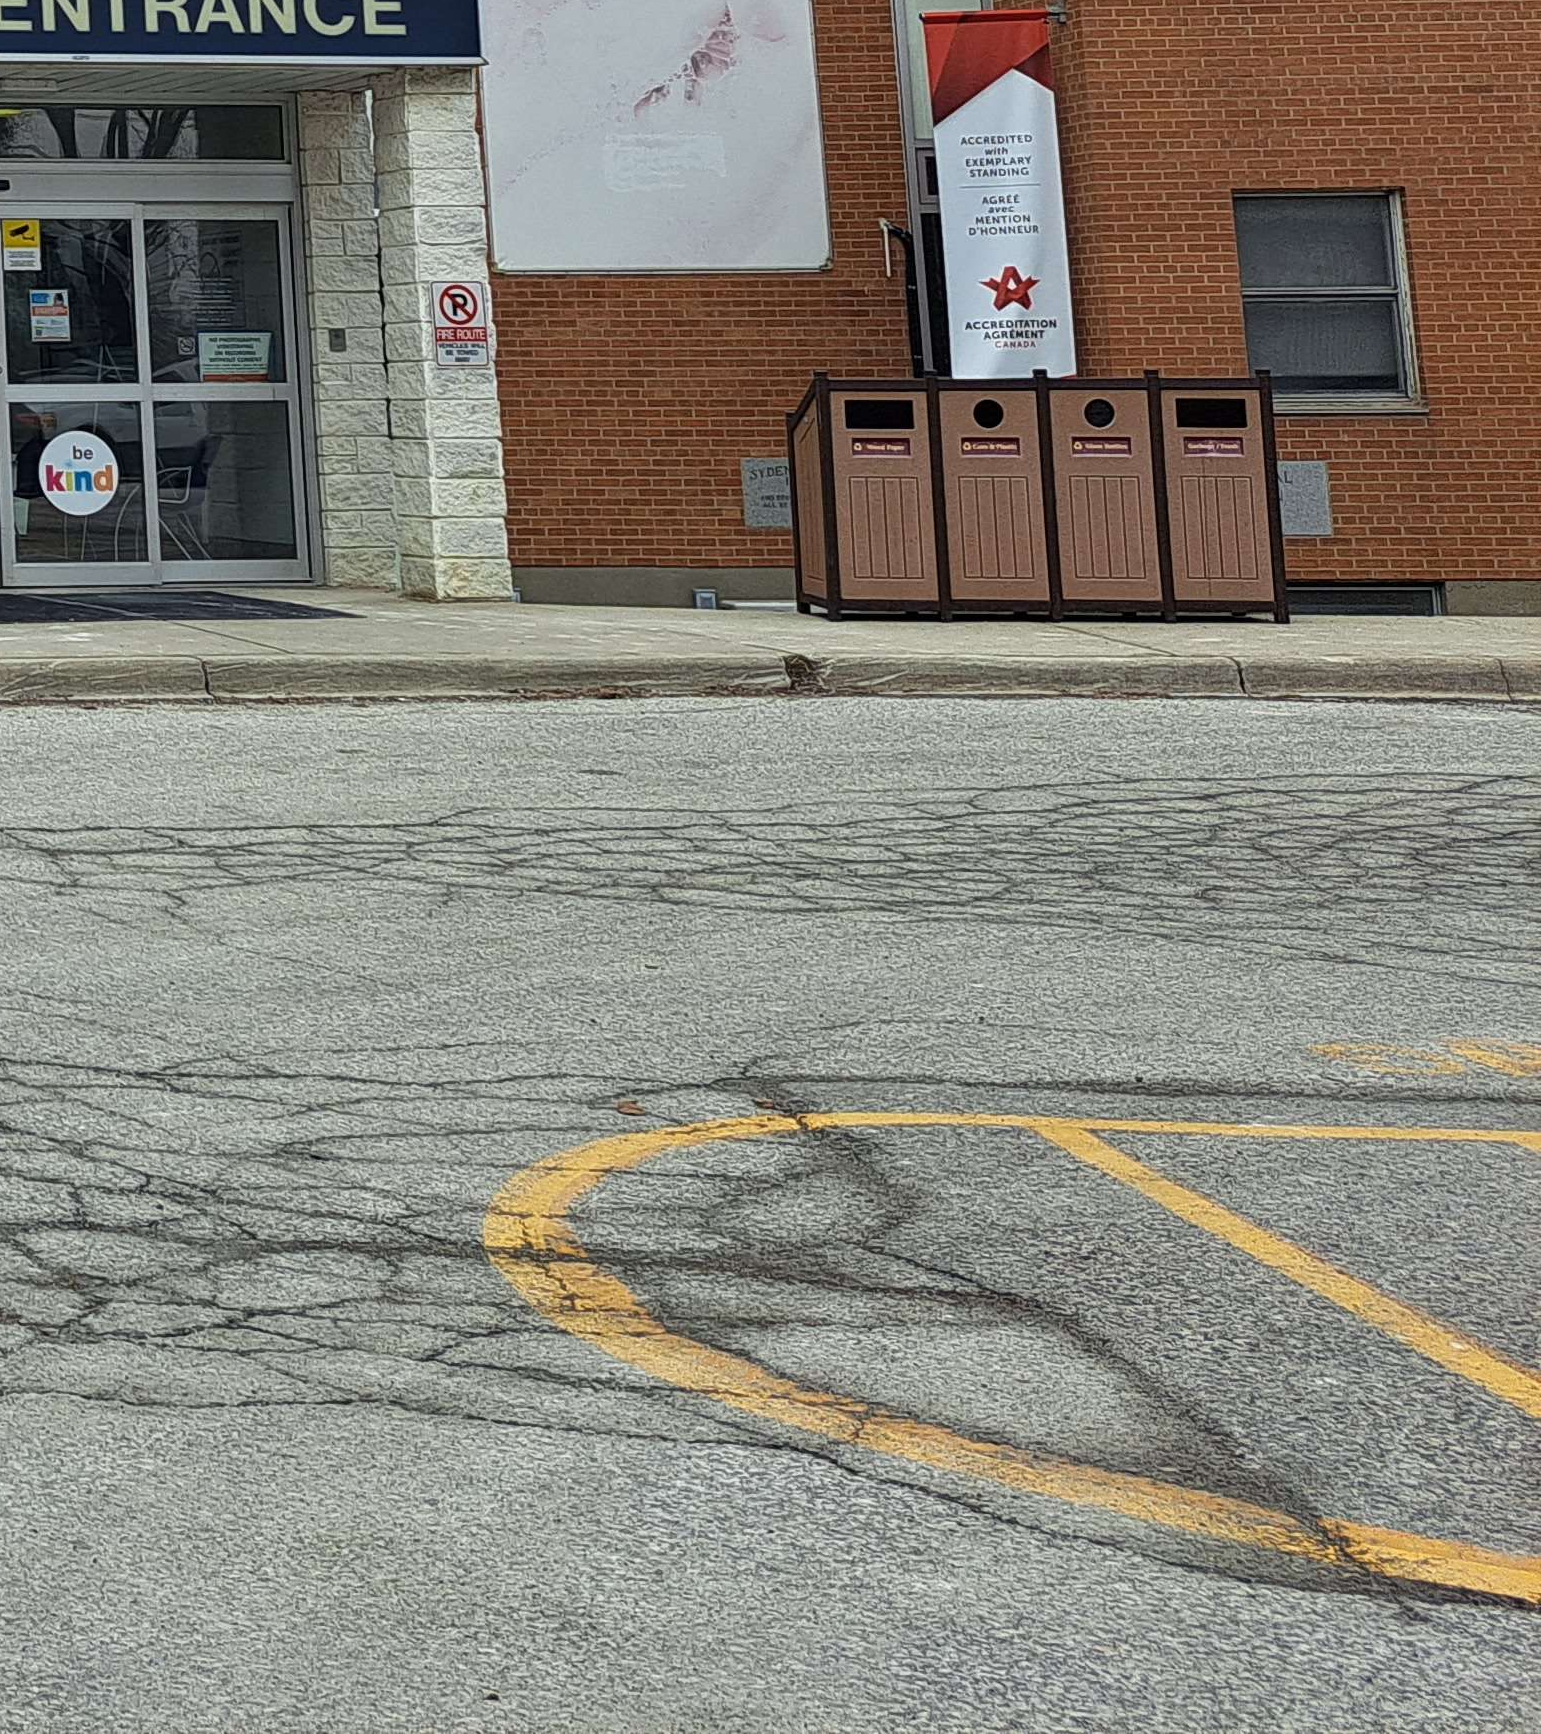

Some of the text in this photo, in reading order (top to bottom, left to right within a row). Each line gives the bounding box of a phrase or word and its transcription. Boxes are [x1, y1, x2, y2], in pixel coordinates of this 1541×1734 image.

[960, 134, 1033, 146] ACCREDITED
[984, 146, 1009, 156] with
[965, 156, 1032, 167] EXEMPLARY
[969, 167, 1030, 178] STANDING
[987, 206, 1015, 214] avec
[975, 214, 1031, 225] MENTION
[968, 225, 1039, 236] D'HONNEUR
[965, 319, 1057, 330] ACCREDITATION
[437, 329, 486, 340] FIRE ROUTE
[983, 329, 1045, 340] AGRÉMENT
[995, 340, 1036, 349] CANADA
[72, 445, 94, 460] be
[45, 464, 114, 492] kind
